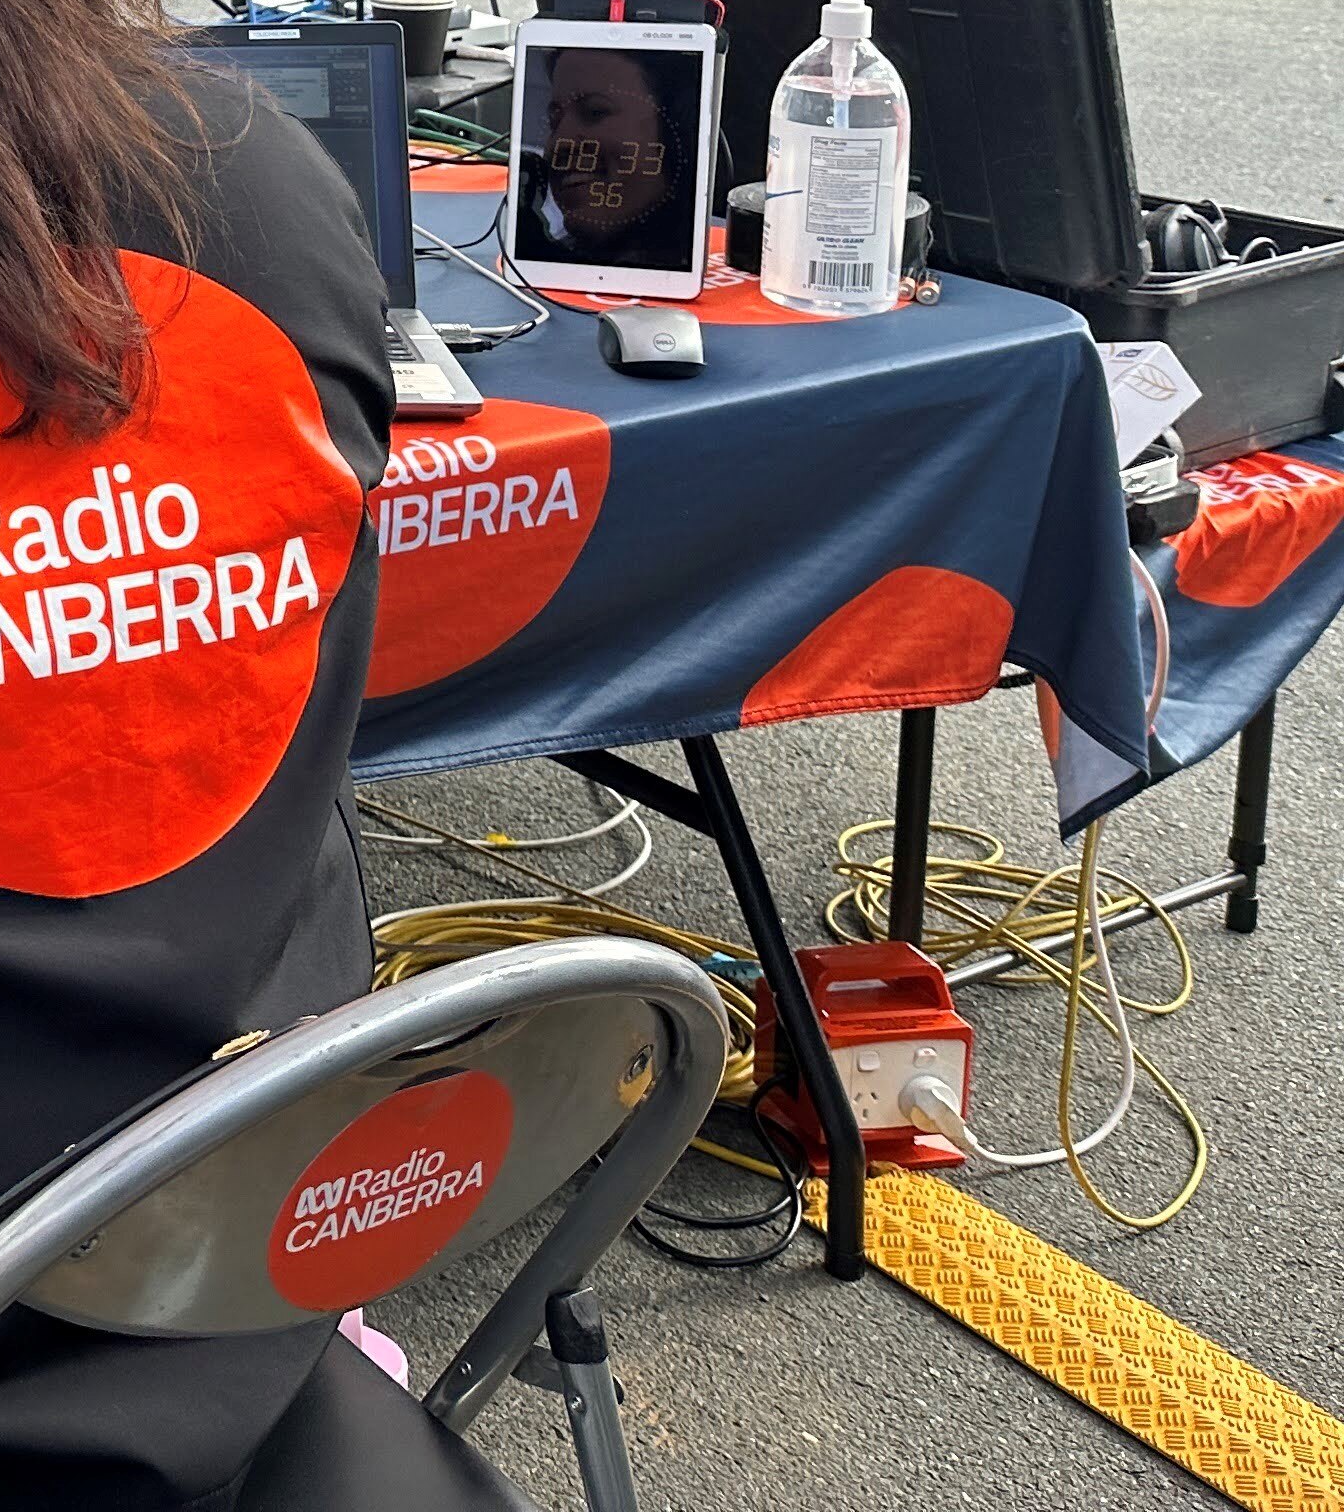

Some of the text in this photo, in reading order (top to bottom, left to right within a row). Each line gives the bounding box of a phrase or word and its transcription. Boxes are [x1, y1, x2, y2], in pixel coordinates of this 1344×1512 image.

[551, 138, 666, 176] 08 33
[589, 181, 624, 209] 56
[382, 433, 497, 488] adio
[378, 466, 580, 558] BERRA
[343, 1146, 446, 1203] Radio
[284, 1160, 484, 1254] CANBERRA
